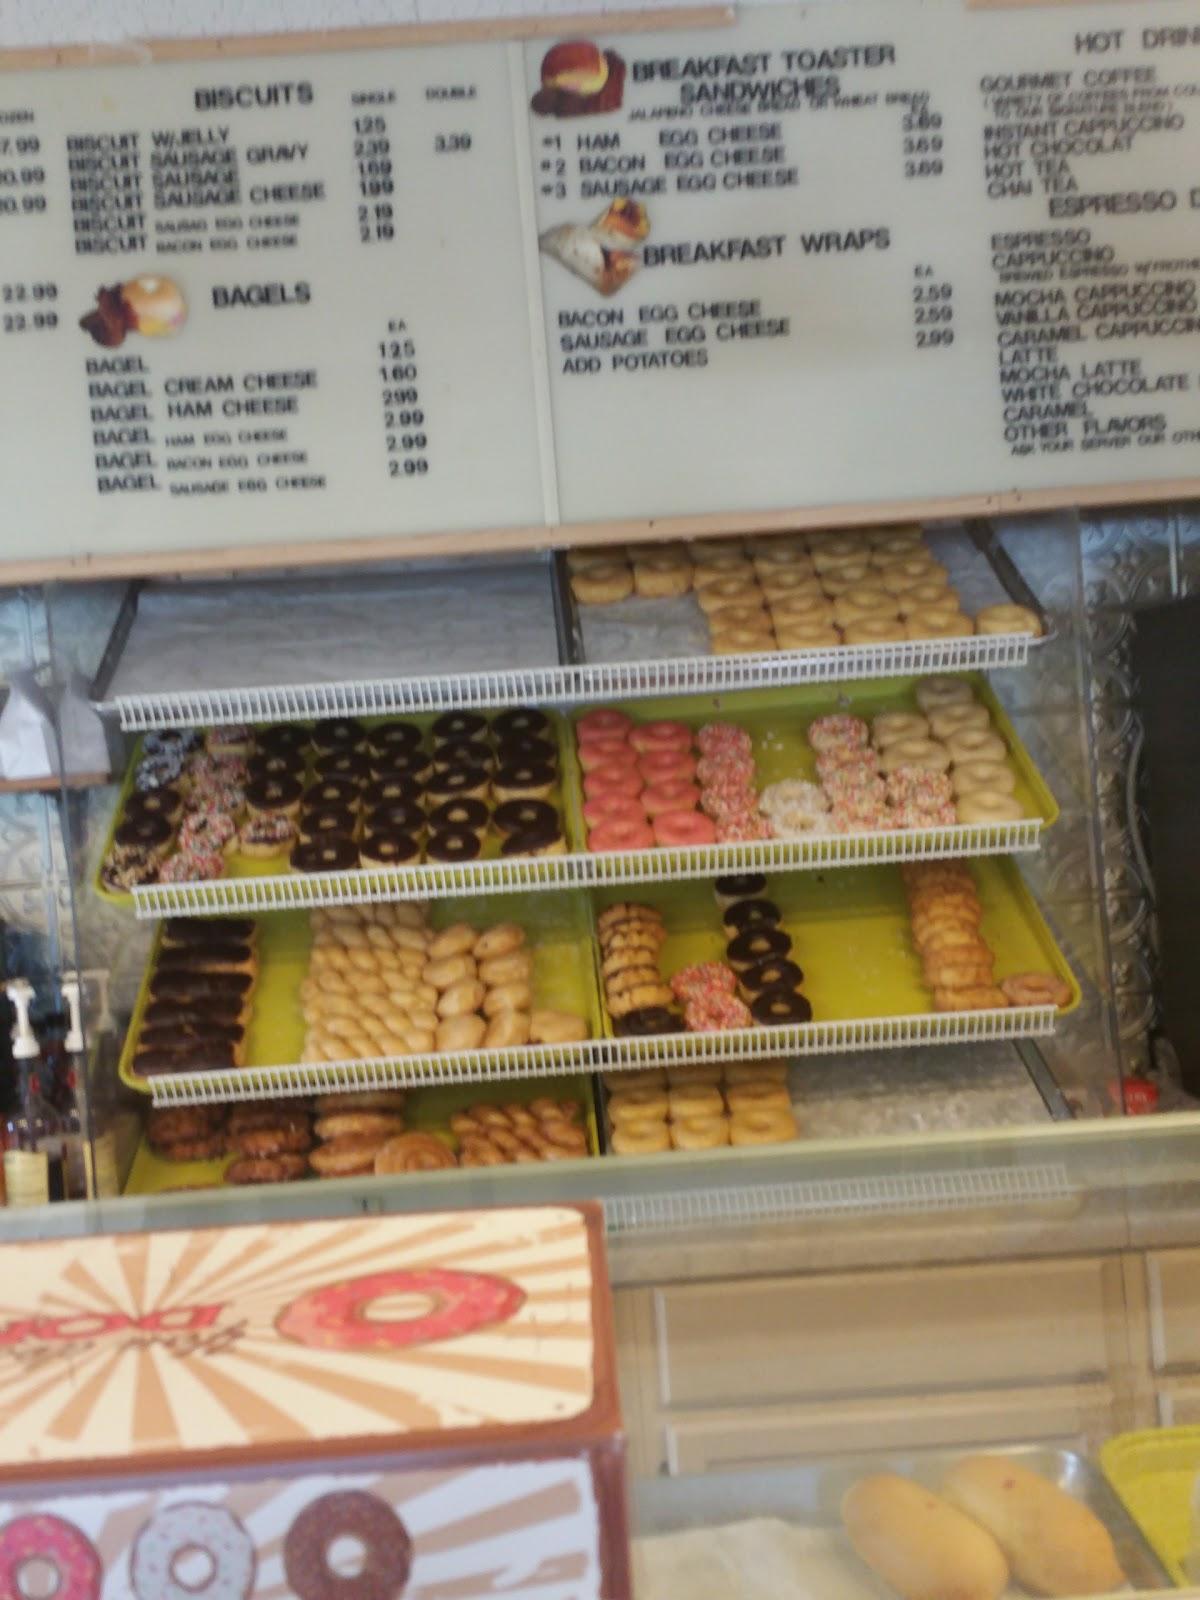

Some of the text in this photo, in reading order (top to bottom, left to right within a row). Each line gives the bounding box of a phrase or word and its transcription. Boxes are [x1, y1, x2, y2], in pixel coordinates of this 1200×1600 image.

[1074, 31, 1124, 54] HOT
[632, 44, 895, 82] BREAKFAST TOASTER
[680, 75, 840, 104] SANDWICHES
[980, 65, 1156, 93] GOURMET COFFEE
[194, 81, 313, 111] BISCUITS
[67, 131, 141, 152] BISCUIT
[577, 132, 620, 151] HAM
[659, 128, 698, 146] EGG
[708, 122, 781, 144] CHEESE
[984, 120, 1057, 141] INSTANT
[68, 142, 309, 172] BISCUIT SAUSAGE GRAVY
[579, 154, 645, 174] BACON
[664, 150, 703, 170] EGG
[710, 145, 785, 167] CHEESE
[985, 142, 1020, 159] HOT
[70, 169, 237, 192] BISCUIT SAUSAGE
[986, 157, 1071, 180] HOT TEA
[581, 175, 666, 198] SAUSAGE
[677, 172, 716, 192] EGG
[723, 167, 798, 190] CHEESE
[987, 176, 1079, 199] CHAI TEA
[71, 181, 326, 213] BISCUIT SAUSAGE CHEESE
[1049, 190, 1177, 218] ESPRESSO
[73, 213, 145, 234] BISCUIT
[249, 212, 299, 229] CHEESE
[75, 234, 148, 255] BISCUIT
[156, 239, 202, 254] BACON
[246, 233, 297, 250] CHEESE
[643, 227, 891, 268] BREAKFAST WRAPS
[991, 228, 1091, 251] ESPRESSO
[992, 244, 1115, 271] CAPPUCCINO
[212, 281, 311, 309] BAGELS
[995, 278, 1196, 307] MOCHA CAPPUCCINO
[559, 299, 760, 329] BACON EGG CHEESE
[996, 298, 1198, 325] VANILLA CAPPUCCINO
[561, 316, 790, 352] SAUSAGE EGG CHEESE
[997, 324, 1087, 347] CARAMEL
[85, 356, 149, 376] BAGEL
[563, 348, 708, 374] ADD POTATOES
[999, 347, 1058, 367] LATTE
[88, 369, 318, 399] BAGEL CREAM CHEESE
[1000, 358, 1141, 384] MOCHA LATTE
[1002, 374, 1189, 403] WHITE CHOCOLATE
[90, 397, 299, 423] BAGEL HAM CHEESE
[1003, 400, 1092, 423] CARAMEL
[93, 427, 288, 448] BAGEL HAM EGG CHEESE
[1004, 413, 1167, 442] OTHER FLAVORS
[95, 450, 307, 471] BAGEL BACON EGG CHEESE
[97, 474, 160, 494] BAGEL
[170, 480, 229, 496] SAUSAGE
[275, 475, 327, 490] CHEESE
